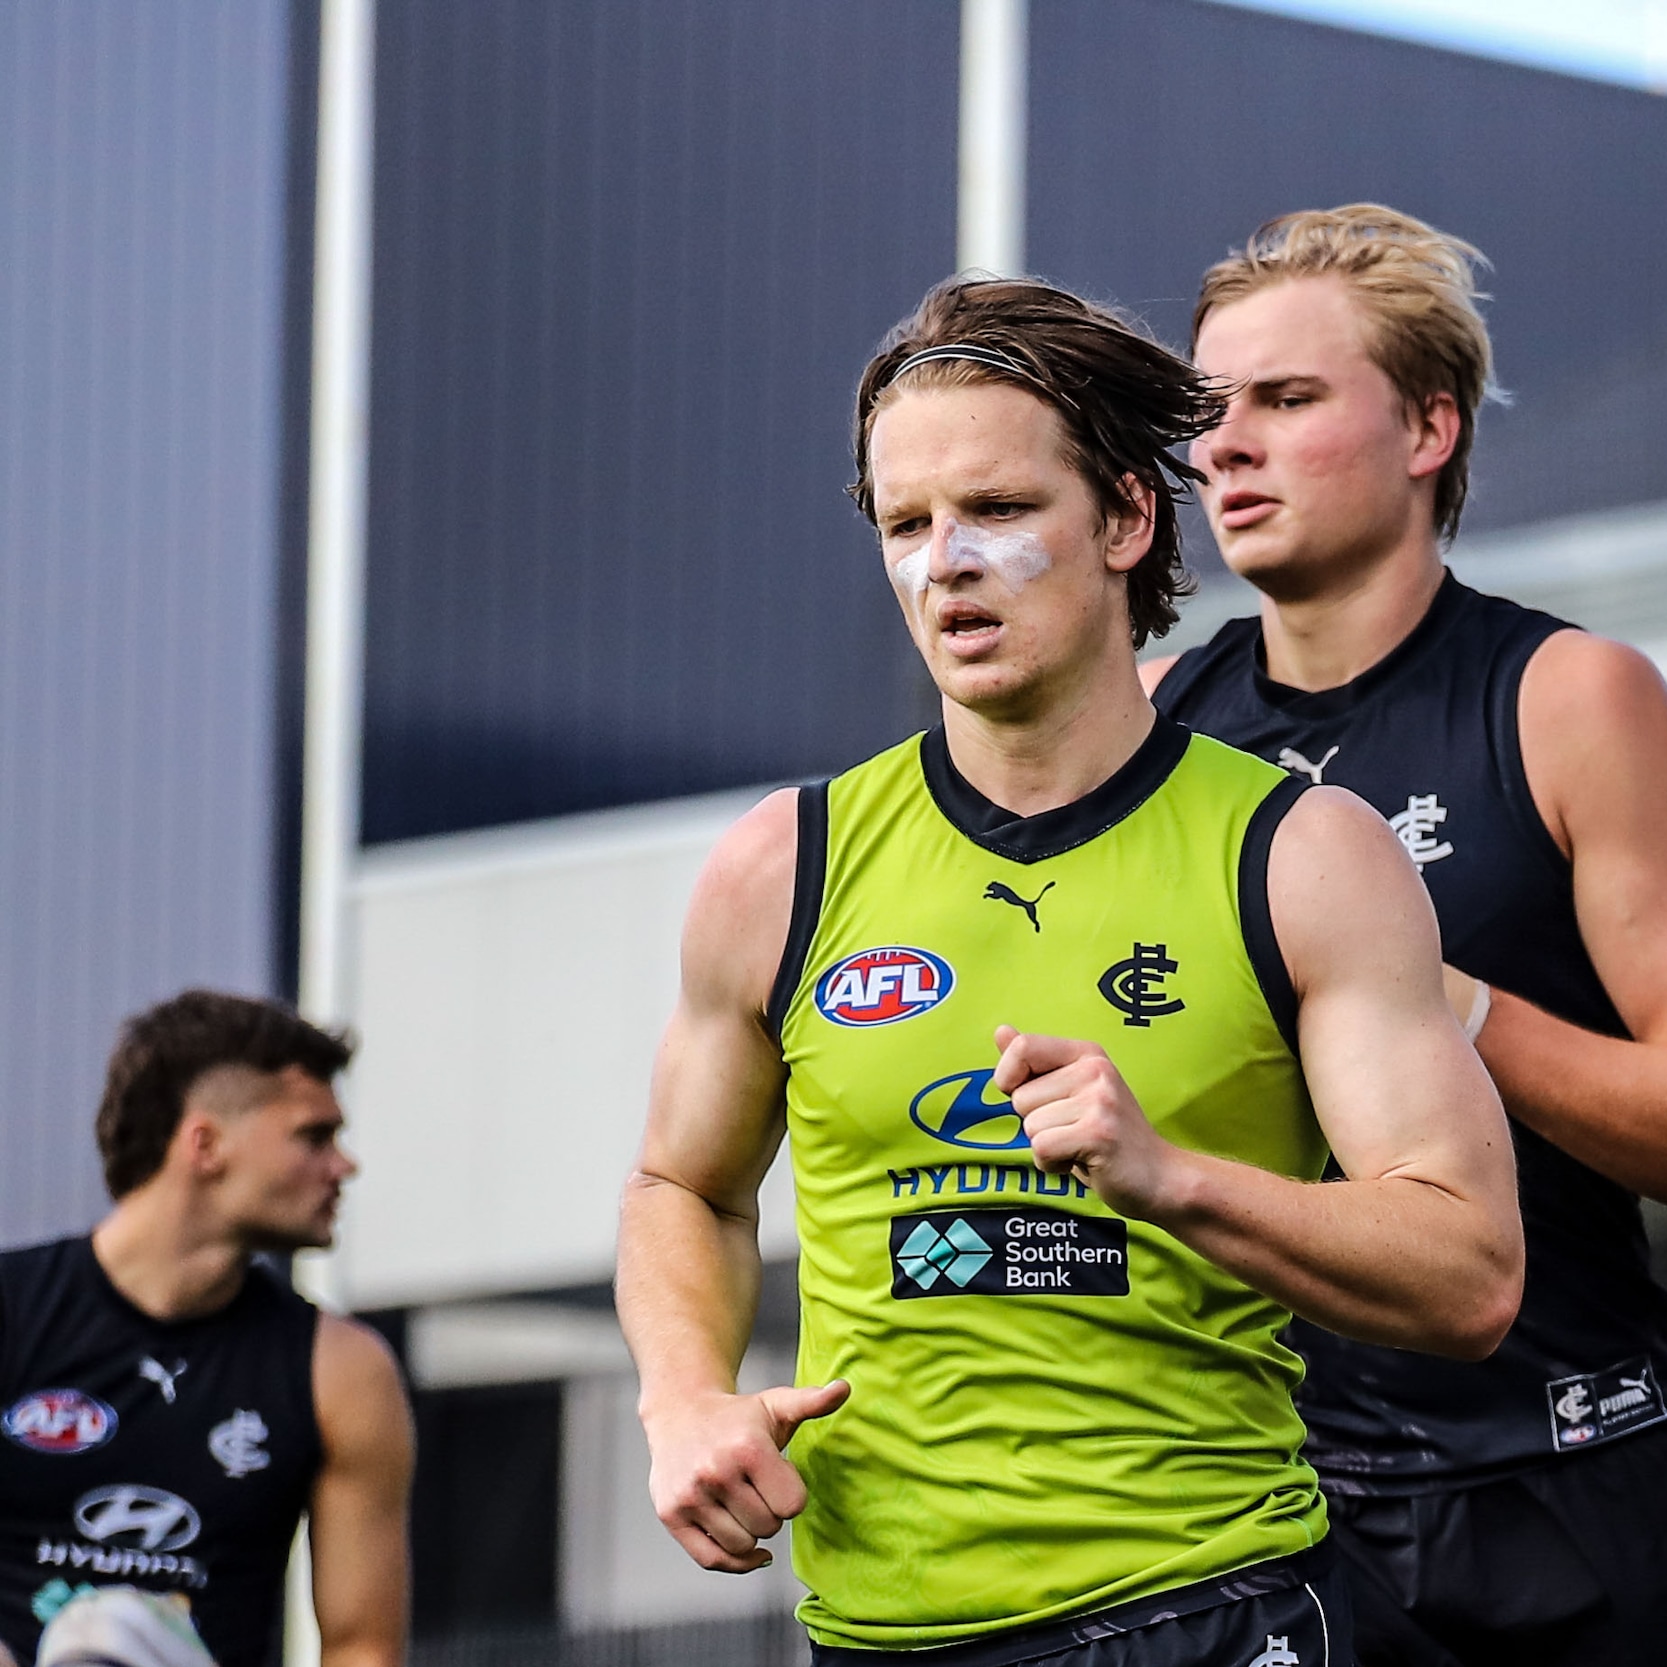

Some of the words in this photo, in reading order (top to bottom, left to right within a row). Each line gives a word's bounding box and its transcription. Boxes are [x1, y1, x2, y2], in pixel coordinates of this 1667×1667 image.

[822, 963, 939, 1011] AFL
[887, 1164, 1090, 1198] HYUND
[1005, 1217, 1078, 1238] Great
[1005, 1241, 1122, 1265] Southern
[1005, 1265, 1072, 1288] Bank
